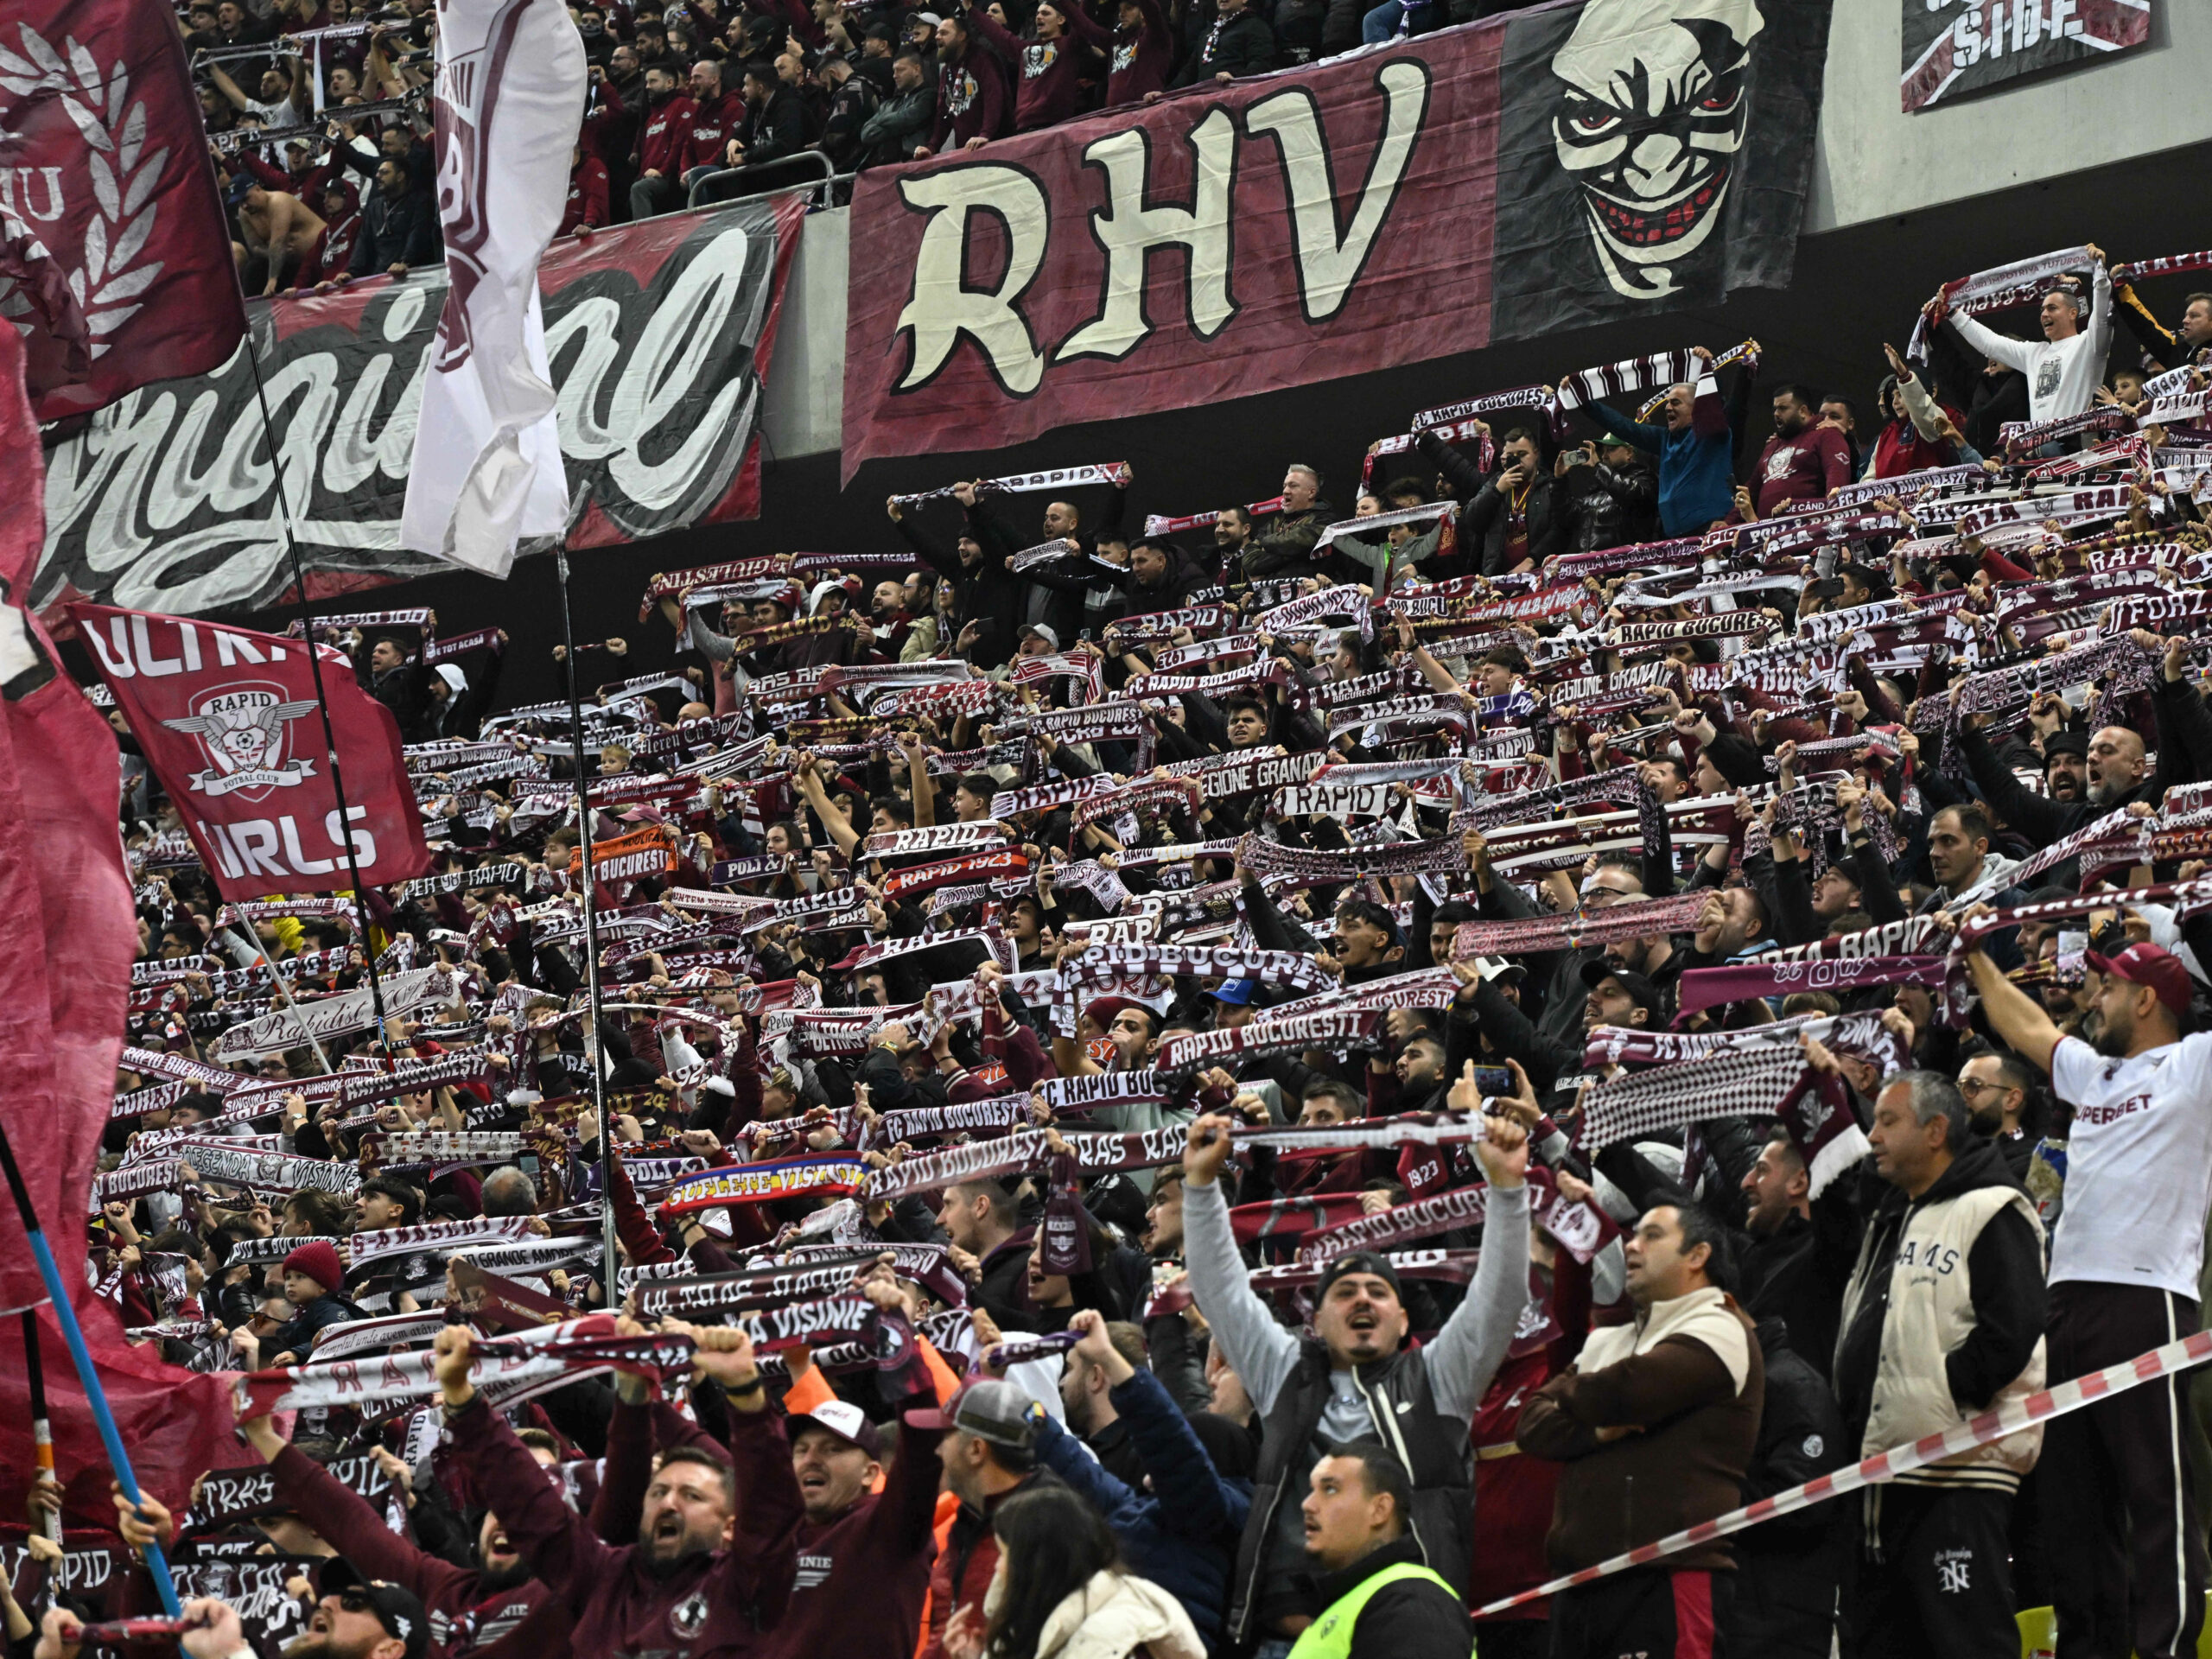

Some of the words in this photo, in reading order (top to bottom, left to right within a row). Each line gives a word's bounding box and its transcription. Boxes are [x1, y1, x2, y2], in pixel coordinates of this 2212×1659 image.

[1952, 0, 2084, 69] SIDE
[887, 56, 1432, 399] RHV
[1010, 467, 1094, 486] RAPID
[1798, 503, 1825, 512] CÂND
[1839, 495, 1855, 506] FC
[1857, 486, 1894, 504] RAPID
[829, 555, 858, 563] PESTE
[861, 554, 880, 563] TOT
[1189, 587, 1224, 606] APID
[313, 612, 380, 627] RAPID
[383, 610, 427, 625] 100
[764, 616, 831, 646] RAPID
[1141, 607, 1218, 632] RAPID
[1622, 620, 1677, 643] RAPID
[1813, 604, 1887, 639] RAPID
[81, 614, 286, 678] ULTR
[447, 641, 459, 654] TOT
[1148, 671, 1194, 690] RAPID
[1322, 671, 1390, 697] RAPID
[1610, 662, 1672, 693] GRANATA
[210, 692, 272, 715] RAPID
[1030, 721, 1045, 734] FC
[1046, 710, 1080, 731] RAPID
[1497, 734, 1535, 760] RAPID
[416, 758, 429, 771] FC
[432, 752, 460, 768] RAPID
[1257, 750, 1327, 785] GRANATA
[1325, 764, 1366, 779] SINGURI
[1366, 760, 1427, 774] IMPOTRIVA
[223, 775, 254, 790] FOTBAL
[257, 772, 280, 785] CLUB
[1014, 779, 1094, 810] RAPID
[1297, 786, 1375, 813] RAPID
[894, 824, 978, 852] RAPID
[728, 860, 762, 878] POLI
[765, 855, 778, 872] &
[1124, 849, 1153, 862] RAPID
[469, 864, 519, 886] RAPID
[900, 865, 966, 889] RAPID
[969, 852, 1012, 871] 1923
[778, 888, 855, 918] RAPID
[1840, 915, 1932, 958] RAPID
[132, 957, 203, 981] RAPID
[254, 1002, 365, 1048] Rapidist
[1171, 1028, 1231, 1066] RAPID
[1243, 1007, 1360, 1048] BUCURESTI
[1654, 1037, 1676, 1058] FC
[123, 1047, 163, 1071] RAPID
[165, 1058, 235, 1087] BUCUREȘTI
[398, 1055, 487, 1088] BUCUREȘTI
[226, 1091, 266, 1113] SINGURĂ
[303, 1077, 343, 1096] SINGURĂ
[1065, 1077, 1119, 1104] RAPID
[466, 1103, 505, 1131] APID
[887, 1118, 902, 1141] FC
[906, 1108, 943, 1135] RAPID
[1063, 1134, 1126, 1166] TRAS
[185, 1146, 251, 1179] LEGENDA
[292, 1160, 359, 1192] VISINIE
[626, 1165, 671, 1182] POLI
[1407, 1160, 1438, 1188] 1923
[1324, 1214, 1395, 1256] RAPID
[480, 1249, 531, 1268] GRANDE
[778, 1298, 871, 1330] VISINIE
[357, 1333, 378, 1347] unde
[381, 1330, 406, 1344] avem
[405, 1414, 426, 1467] RAPID
